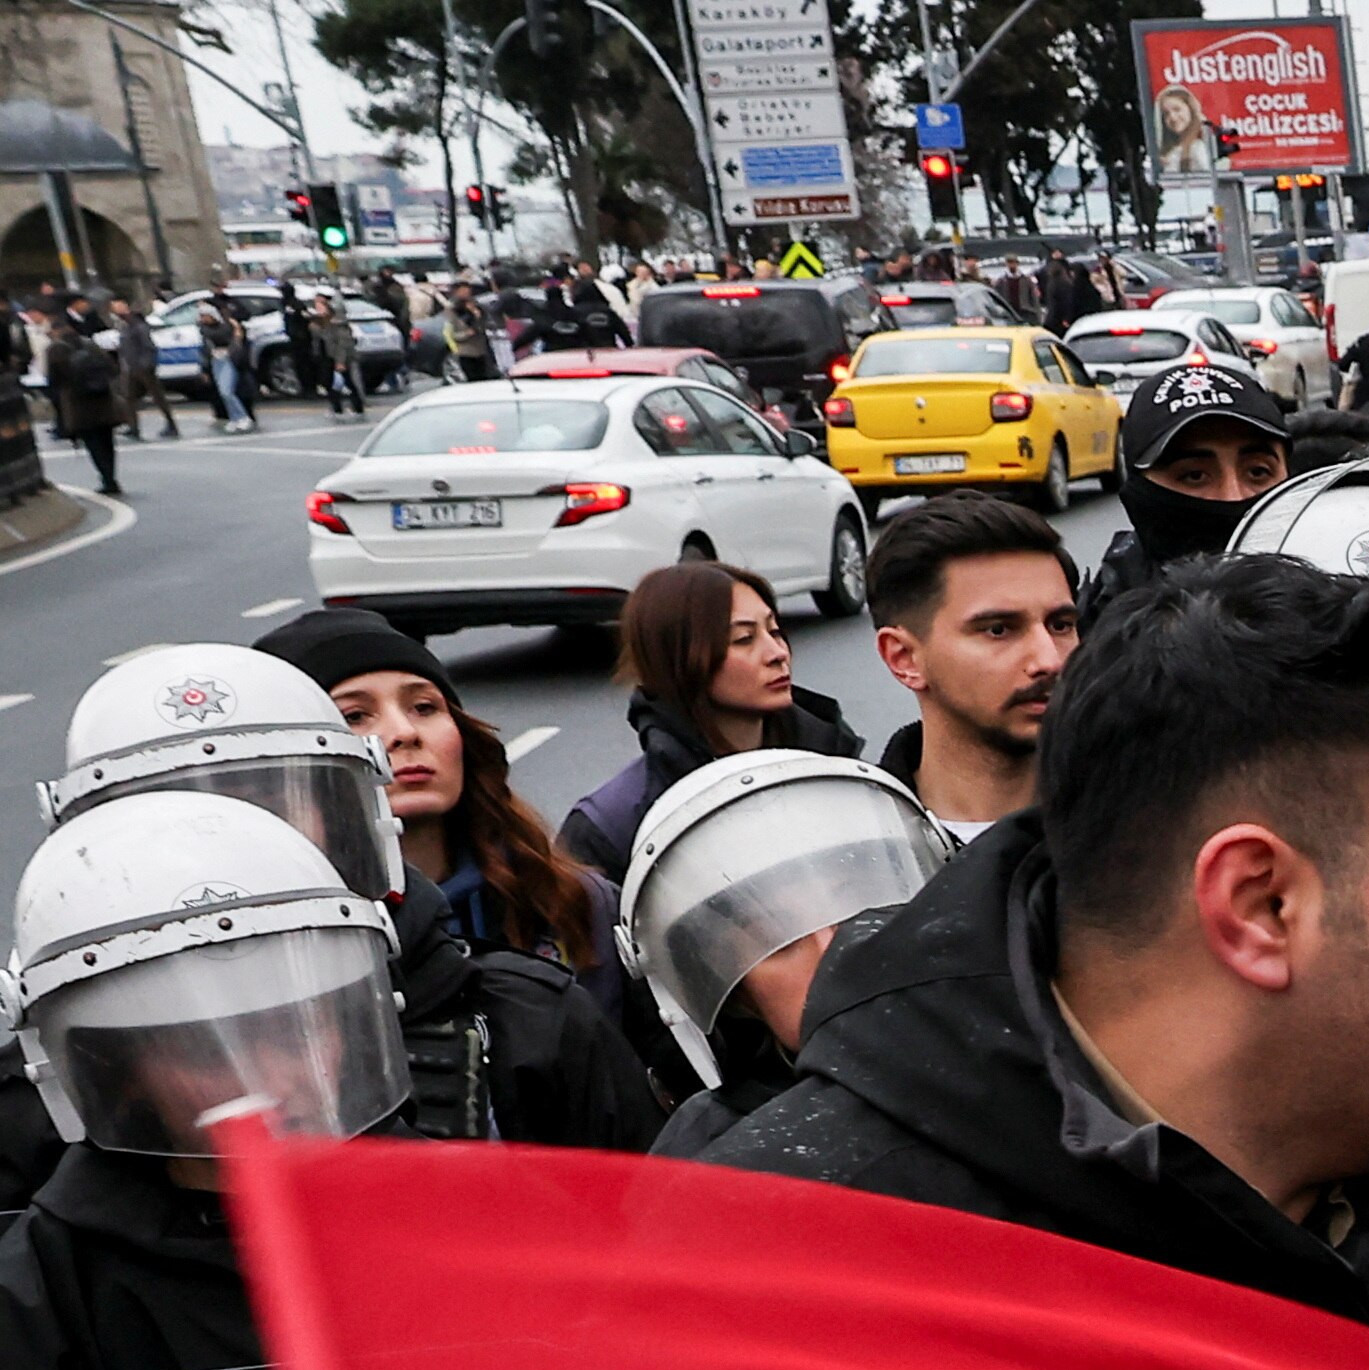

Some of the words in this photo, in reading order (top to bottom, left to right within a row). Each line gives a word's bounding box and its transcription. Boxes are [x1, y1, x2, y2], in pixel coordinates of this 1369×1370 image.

[702, 36, 804, 53] Galataport
[1164, 44, 1327, 86] Justenglish
[1244, 92, 1309, 114] ÇOCUK
